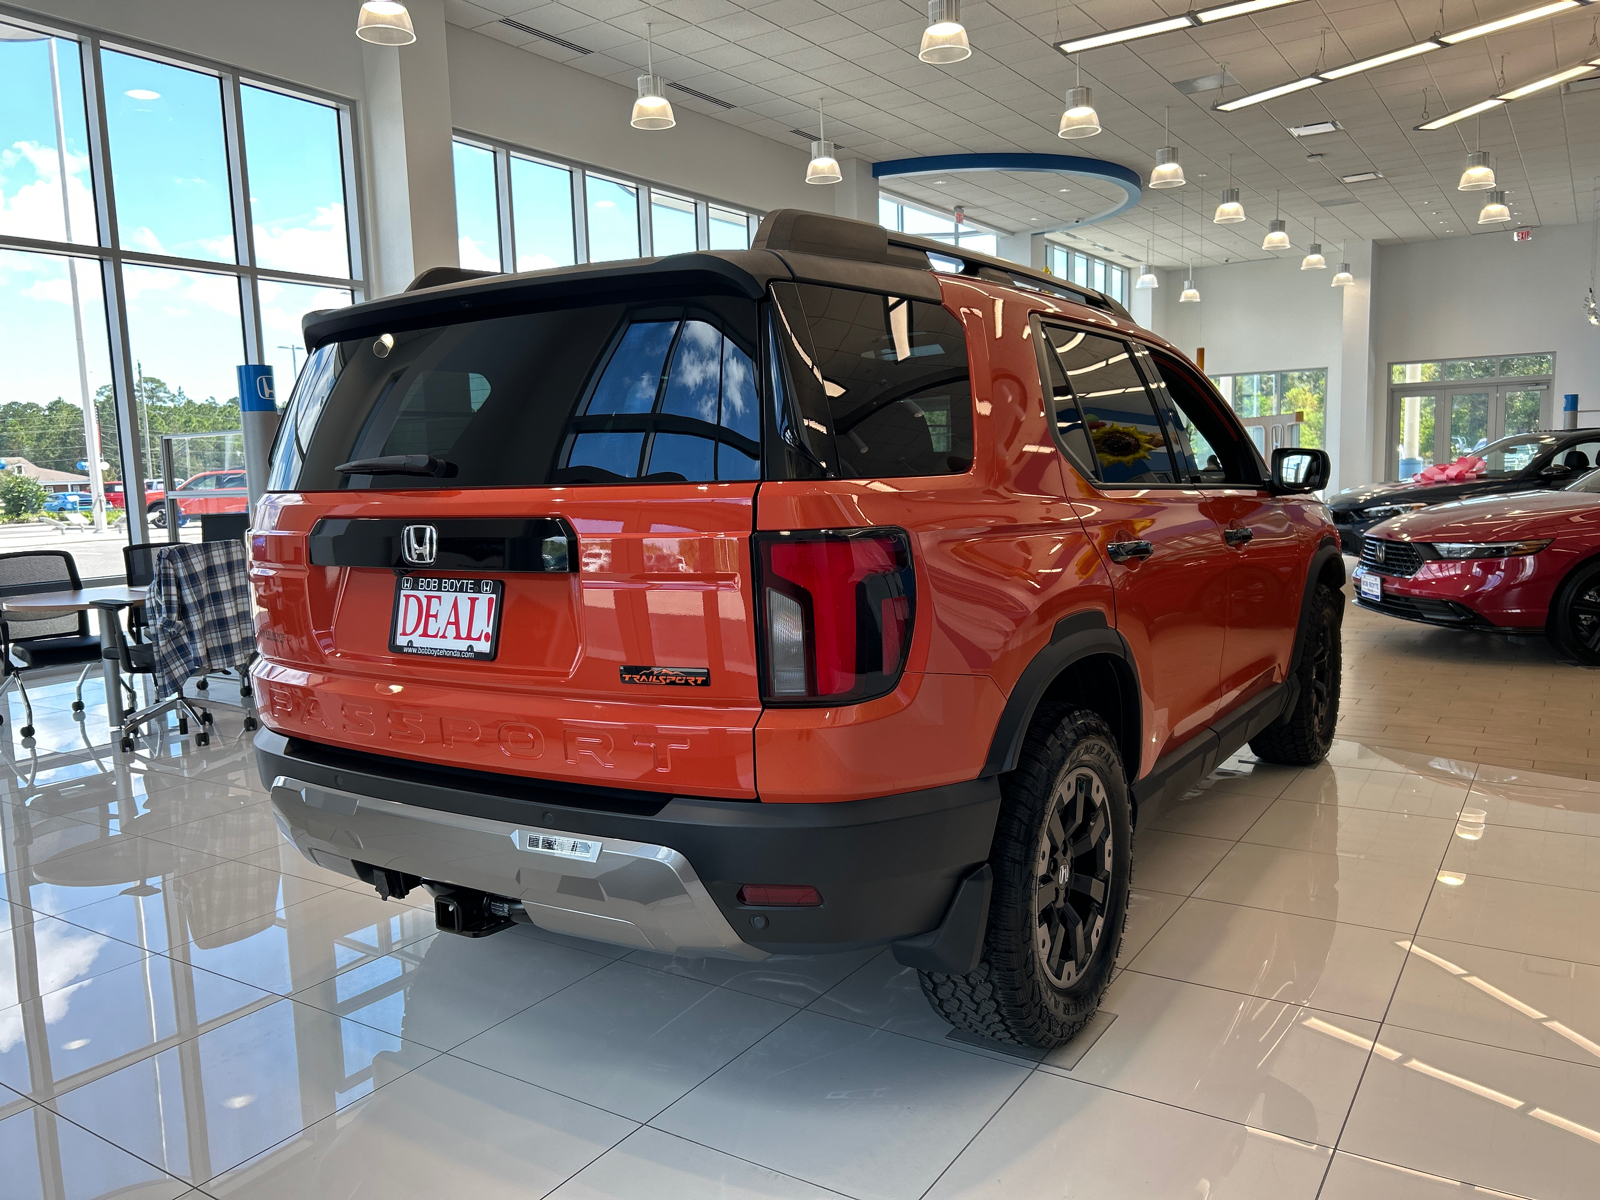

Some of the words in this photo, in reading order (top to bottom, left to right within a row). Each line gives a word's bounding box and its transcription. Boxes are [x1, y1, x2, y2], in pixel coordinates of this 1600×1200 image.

[418, 578, 438, 591] BOB
[441, 579, 475, 592] BOYTE
[399, 594, 495, 643] DEAL!
[403, 646, 475, 658] www.bobboytehonda.com
[622, 674, 707, 686] TRAILSPORT
[269, 689, 691, 773] PASSPORT
